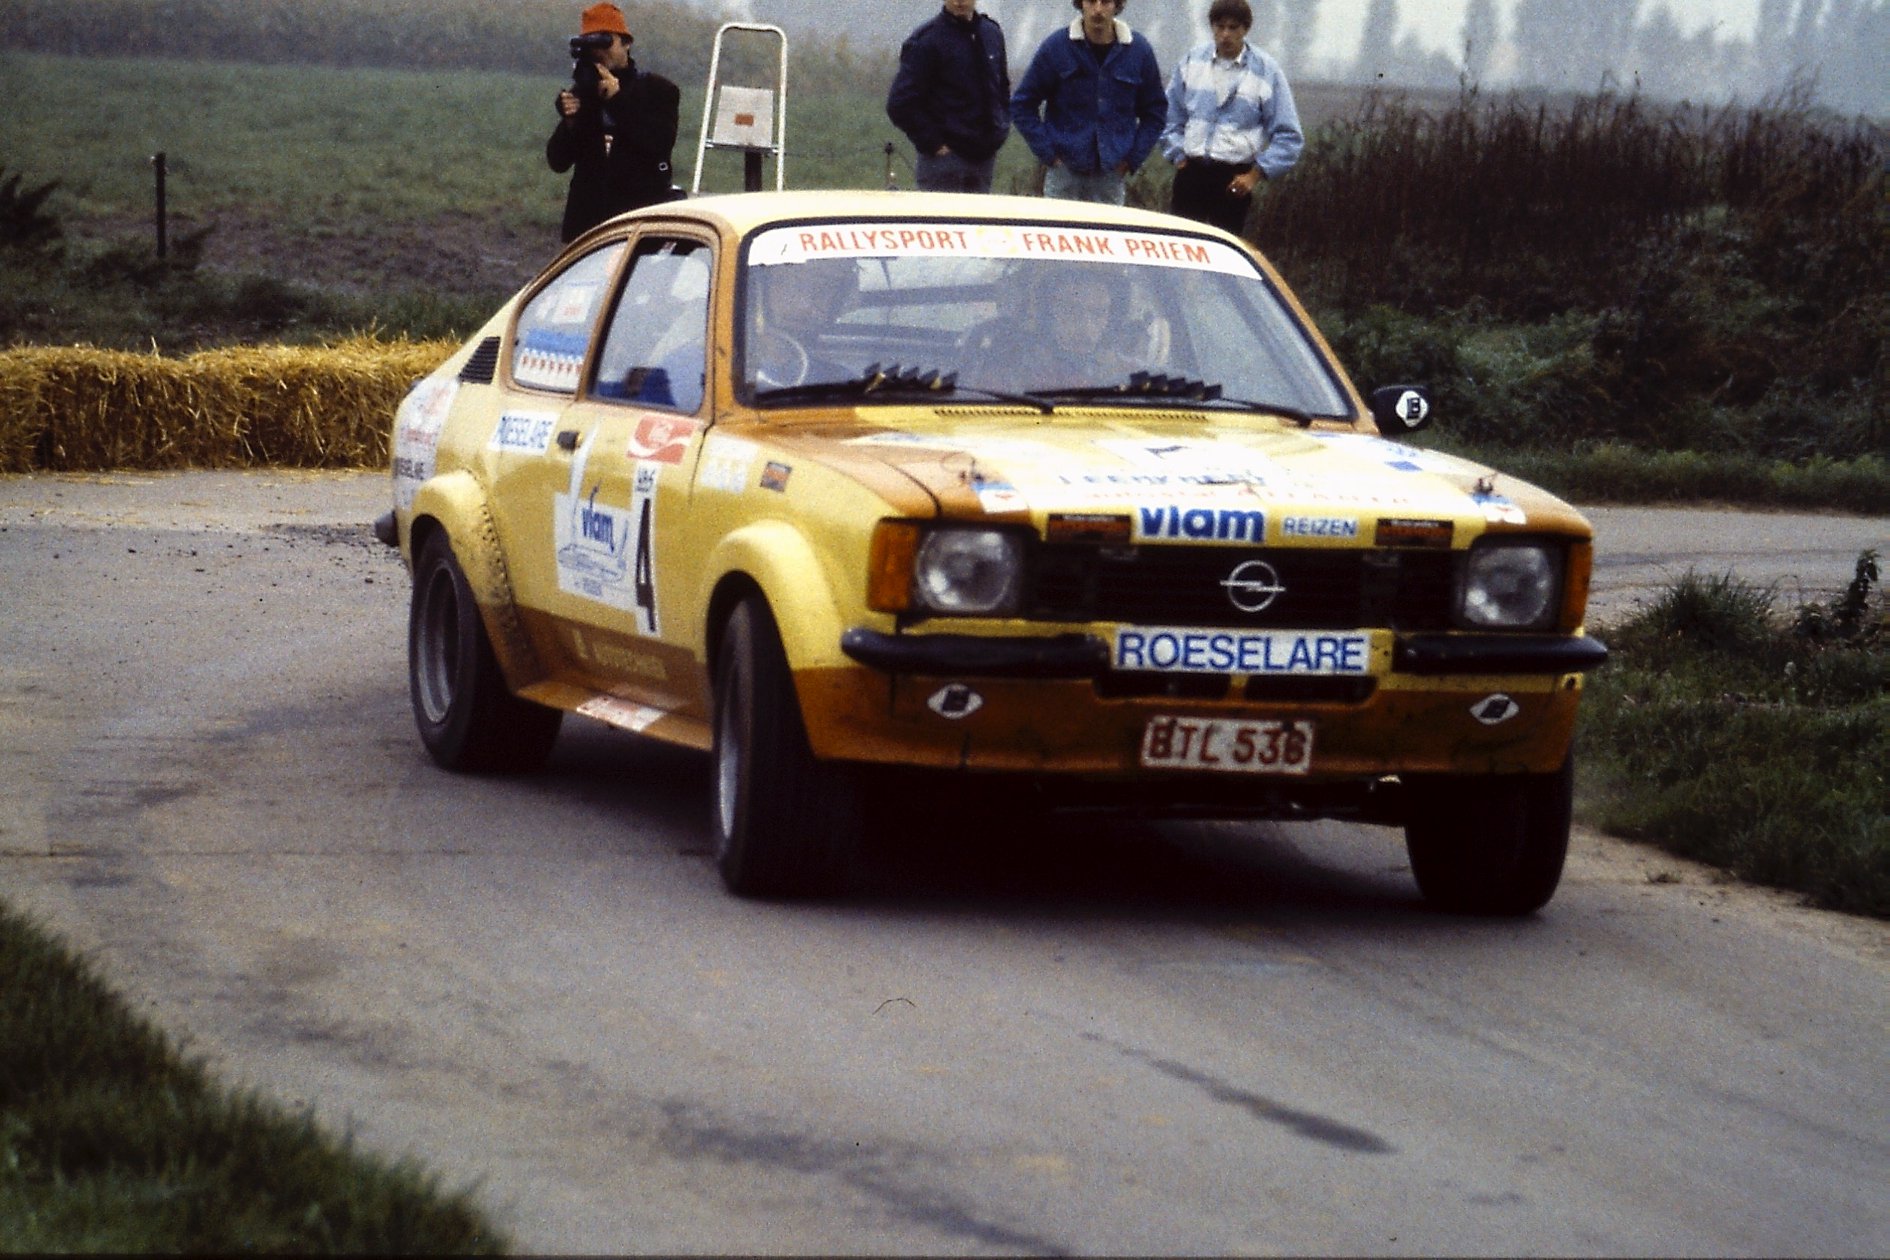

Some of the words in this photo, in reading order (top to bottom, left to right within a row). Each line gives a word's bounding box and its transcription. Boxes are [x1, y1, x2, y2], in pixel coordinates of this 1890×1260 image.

[799, 229, 967, 252] RALLYSPORT
[1022, 233, 1114, 255] FRANK
[1124, 238, 1211, 264] PRIEM
[1284, 517, 1357, 536] REIZEN
[635, 498, 656, 632] 4
[1118, 633, 1365, 671] ROESELARE
